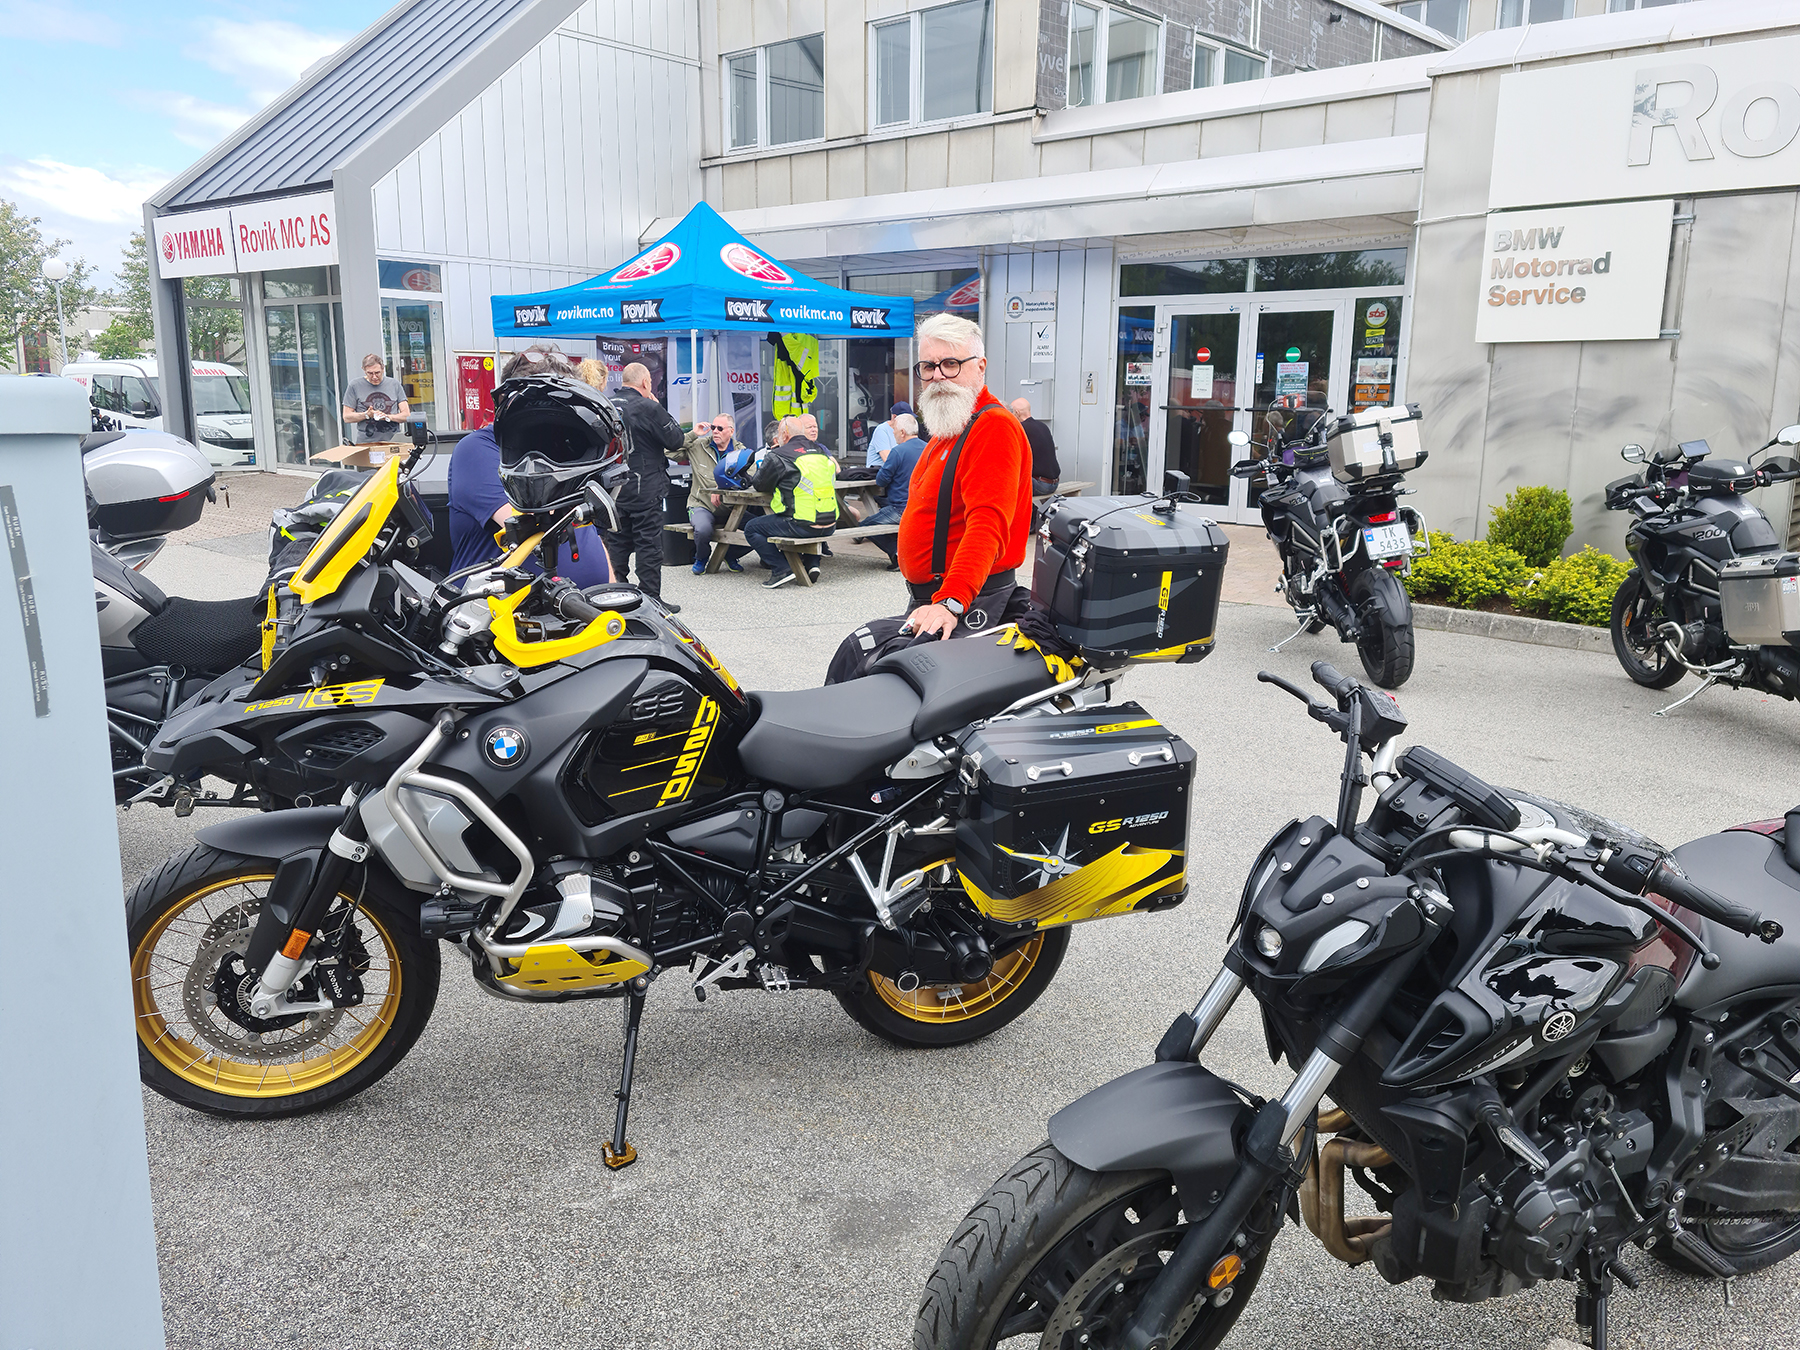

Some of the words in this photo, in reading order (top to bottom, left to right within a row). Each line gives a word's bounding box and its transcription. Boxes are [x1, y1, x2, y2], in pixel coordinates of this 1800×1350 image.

[1628, 63, 1800, 168] Ro
[239, 221, 279, 254] Rovik
[279, 216, 306, 250] MC
[310, 213, 331, 247] AS
[1494, 226, 1565, 252] BMW
[174, 227, 225, 260] YAMAHA
[1490, 251, 1612, 280] Motorrad
[1487, 282, 1587, 307] Service
[515, 305, 546, 324] rovik
[556, 305, 614, 320] rovikmc.no
[622, 300, 658, 320] rovik
[727, 300, 768, 318] rovik
[780, 305, 844, 321] rovikmc.no
[852, 308, 886, 326] rovik
[1368, 308, 1386, 318] sbs
[602, 341, 625, 354] Bring
[603, 354, 622, 363] your
[192, 368, 227, 376] MAHA
[605, 363, 626, 372] drea
[466, 396, 480, 404] ICE
[1382, 526, 1396, 538] TK
[1693, 528, 1723, 540] 1200
[1380, 537, 1406, 552] 5435
[1098, 723, 1129, 733] GS
[489, 730, 520, 745] BMW
[660, 699, 717, 802] 1250
[1088, 818, 1123, 834] GS
[1129, 819, 1160, 829] ADVENTURE
[326, 968, 343, 999] brembo
